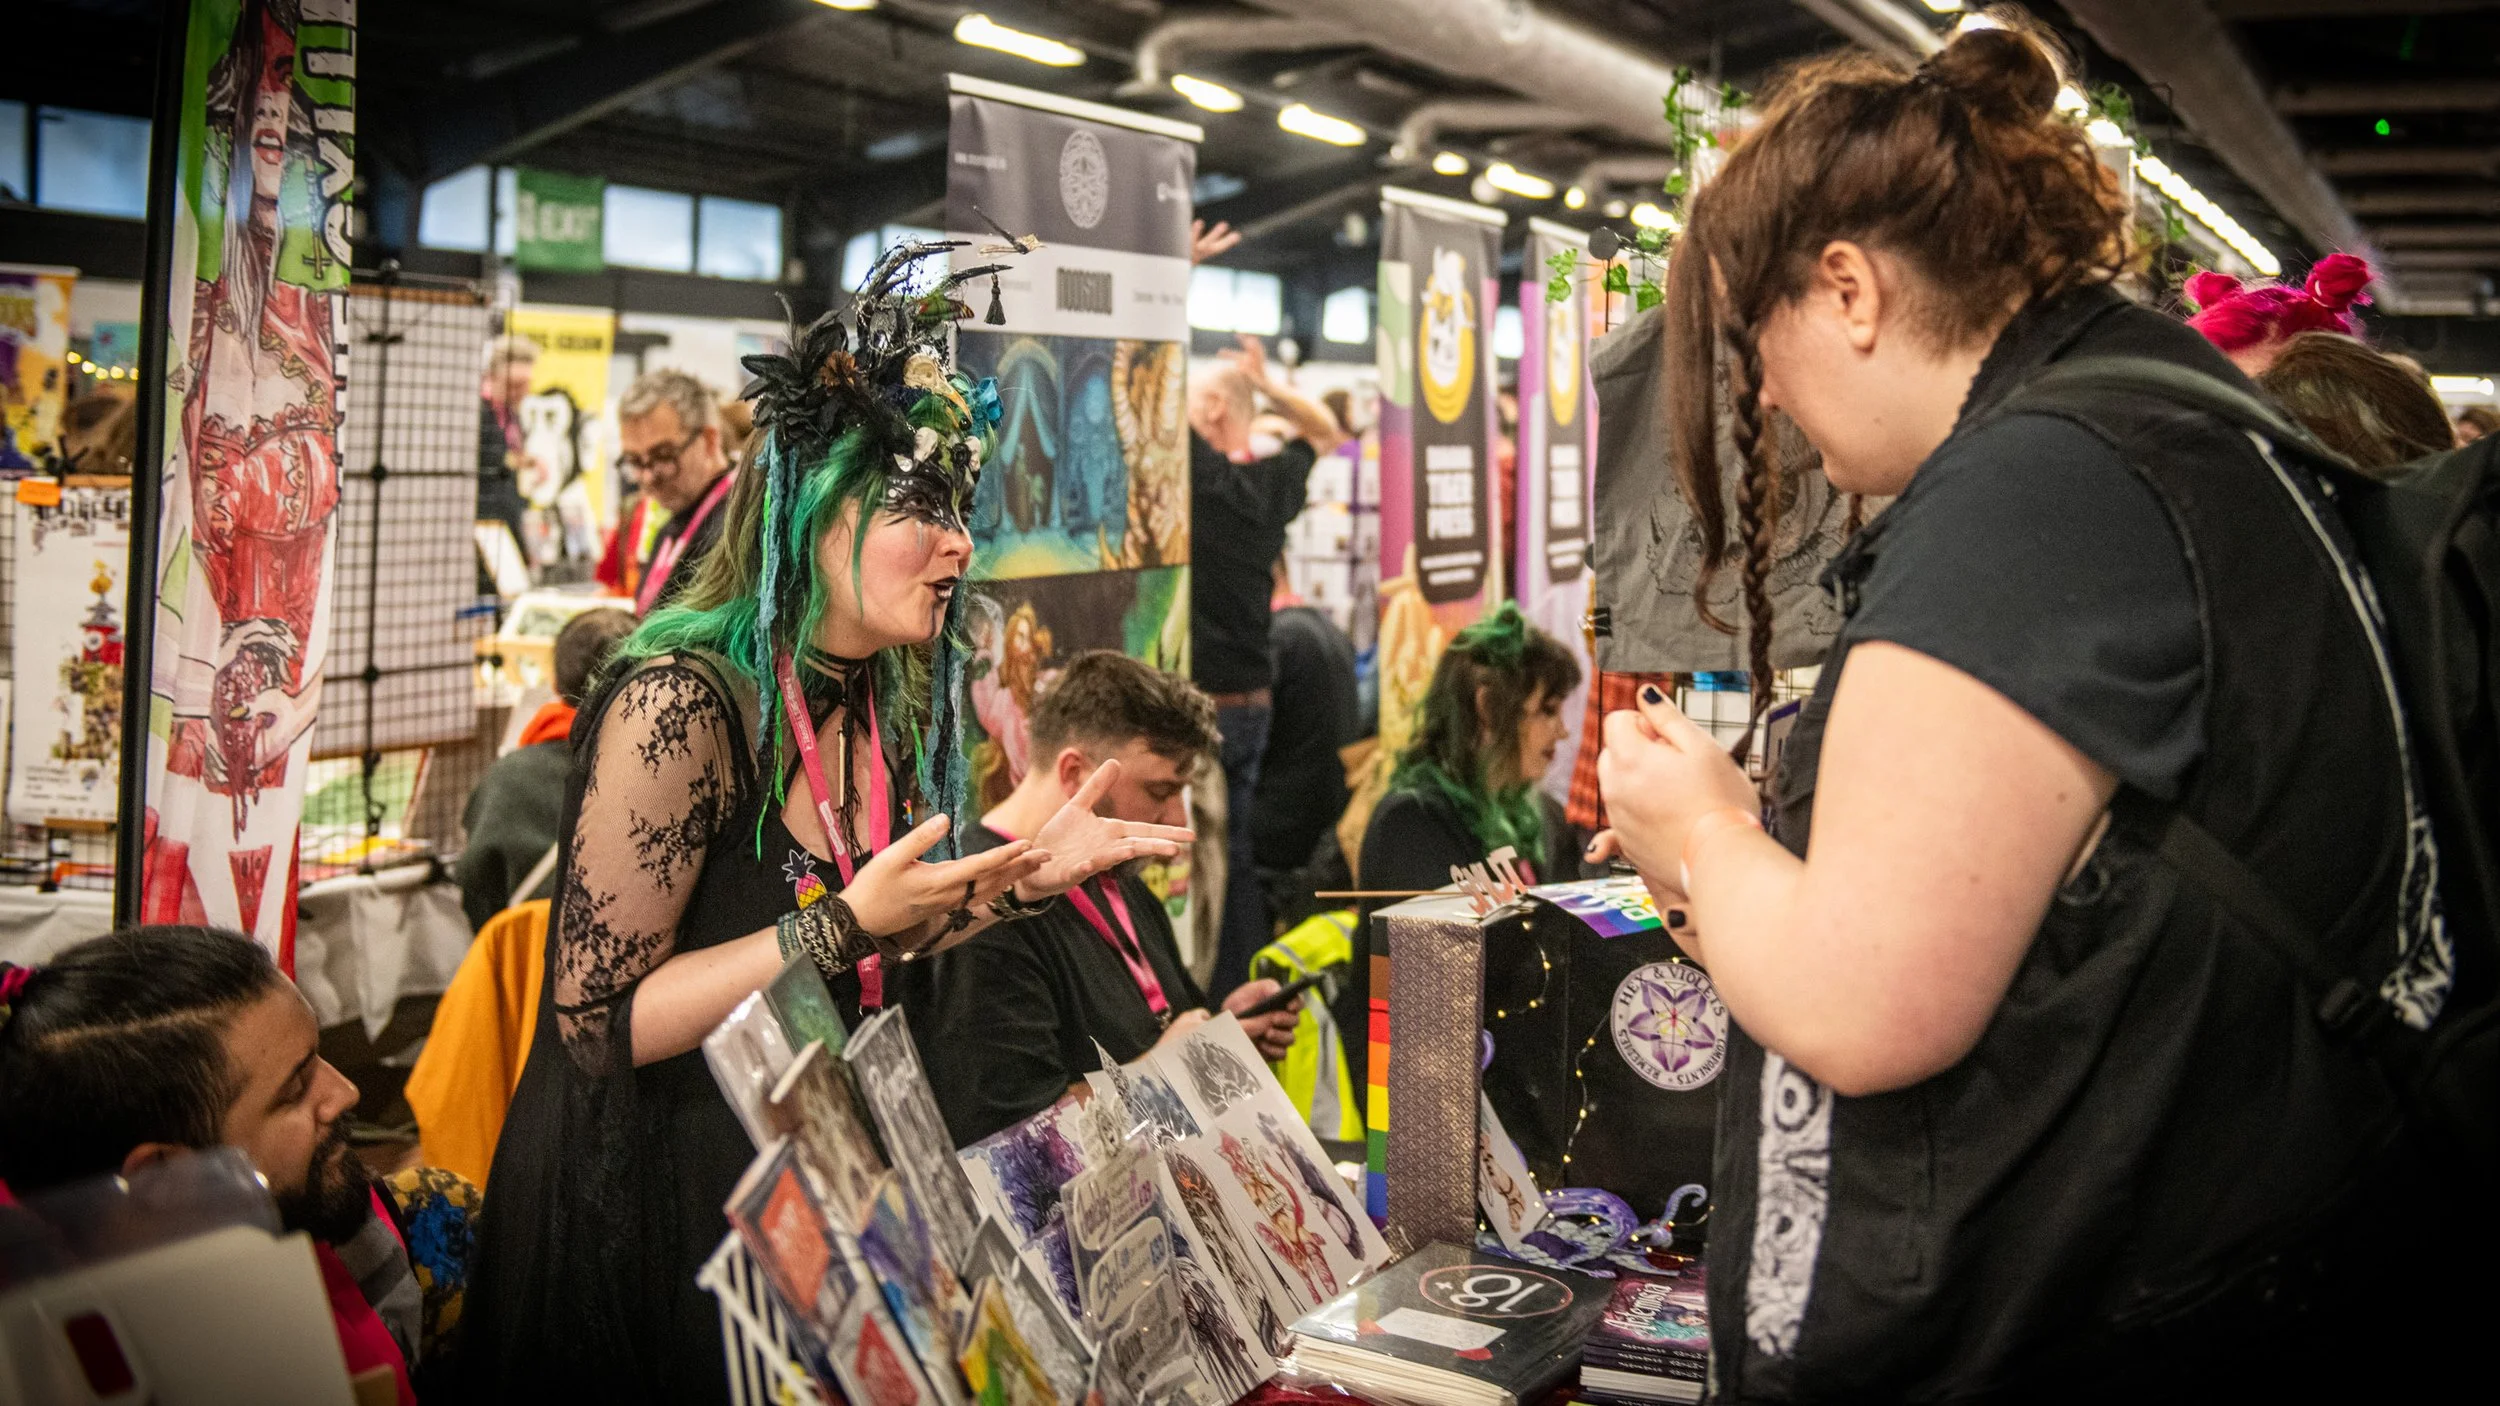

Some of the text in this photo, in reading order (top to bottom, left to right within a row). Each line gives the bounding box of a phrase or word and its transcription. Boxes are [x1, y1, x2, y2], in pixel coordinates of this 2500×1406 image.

[1449, 845, 1528, 917] SMUT
[1619, 966, 1727, 1017] HEX & VIOLETS
[1618, 1028, 1661, 1081] REMEDIES
[1676, 1038, 1726, 1085] COMPONENTS
